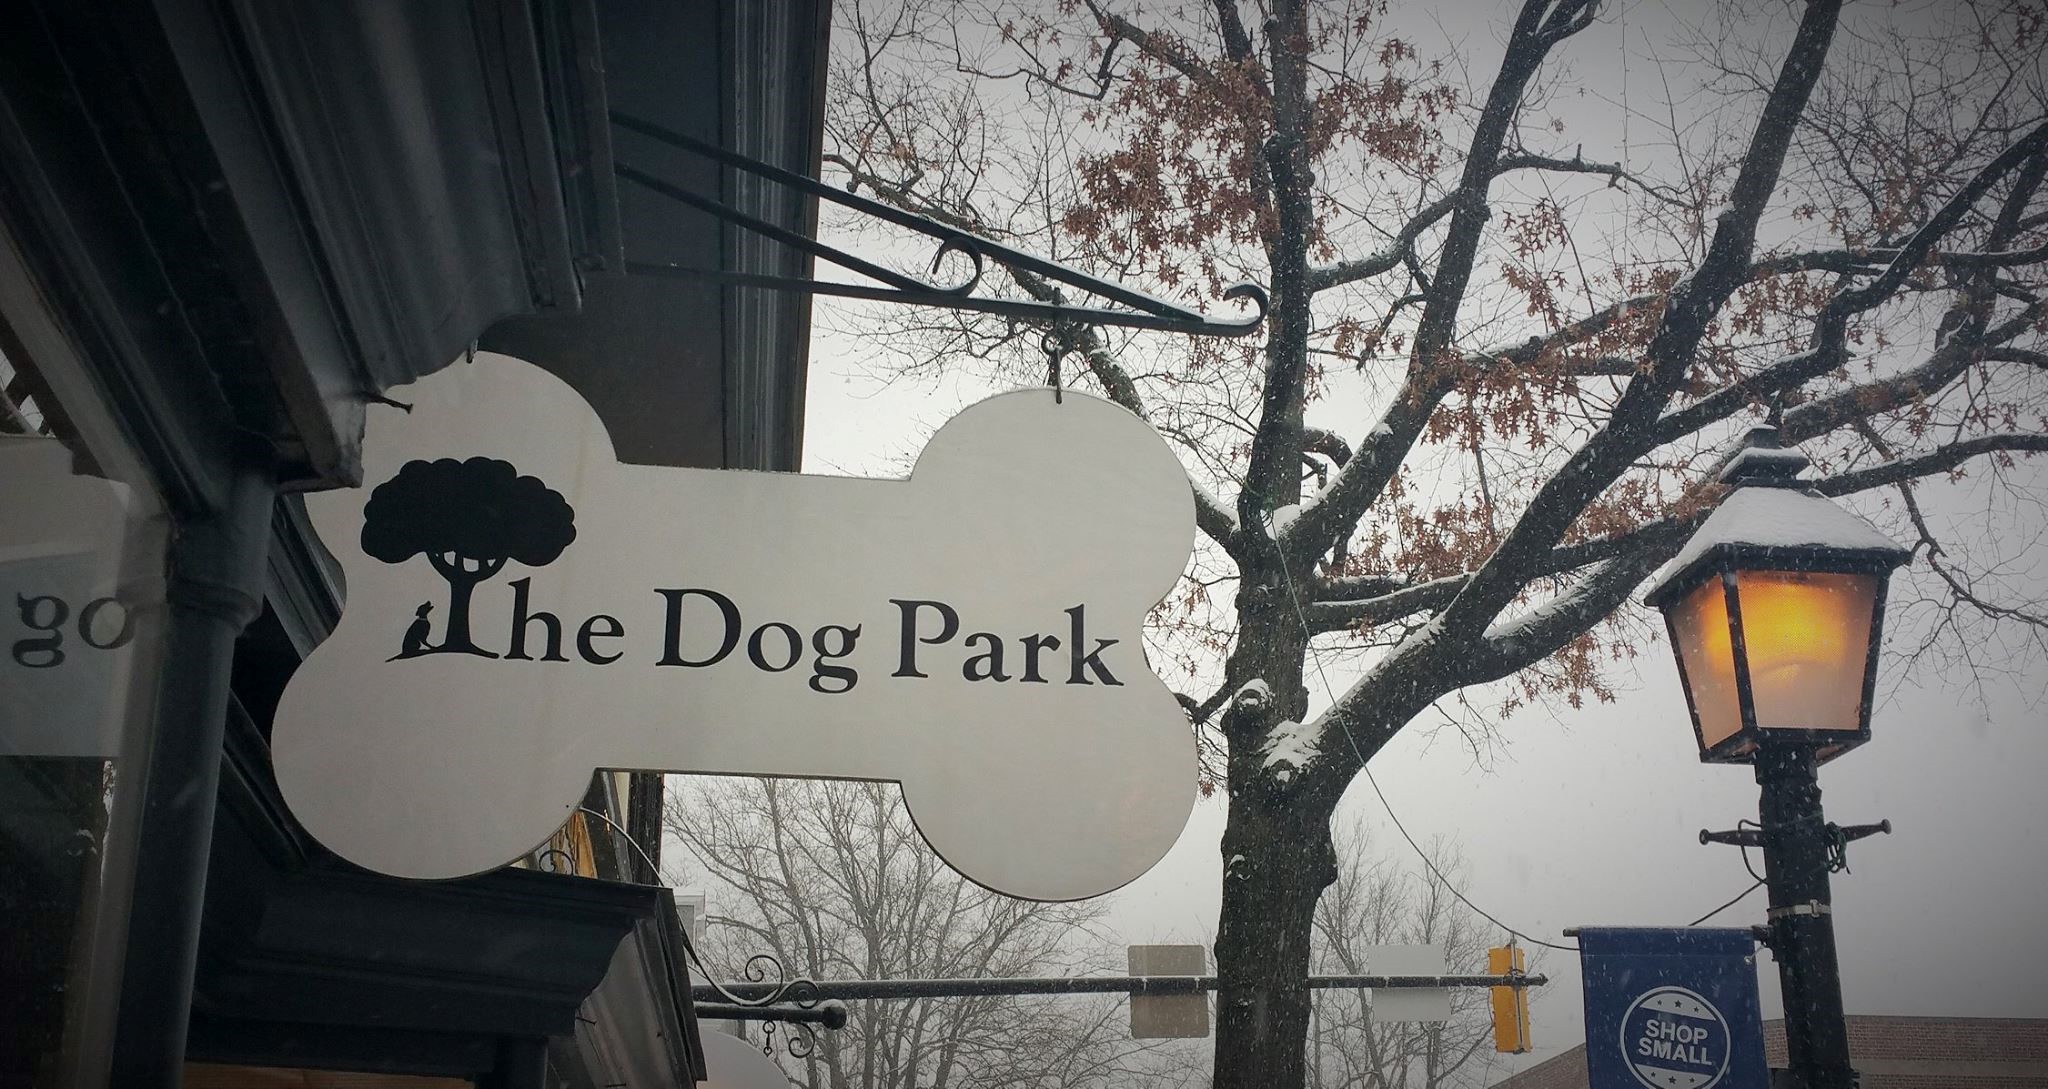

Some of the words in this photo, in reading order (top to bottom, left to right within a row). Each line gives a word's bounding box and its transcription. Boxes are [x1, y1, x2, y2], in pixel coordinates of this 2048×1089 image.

[415, 551, 625, 666] The
[654, 588, 862, 694] Dog
[890, 599, 1125, 687] Park
[1645, 1019, 1709, 1045] SHOP
[1638, 1037, 1713, 1066] SMALL
